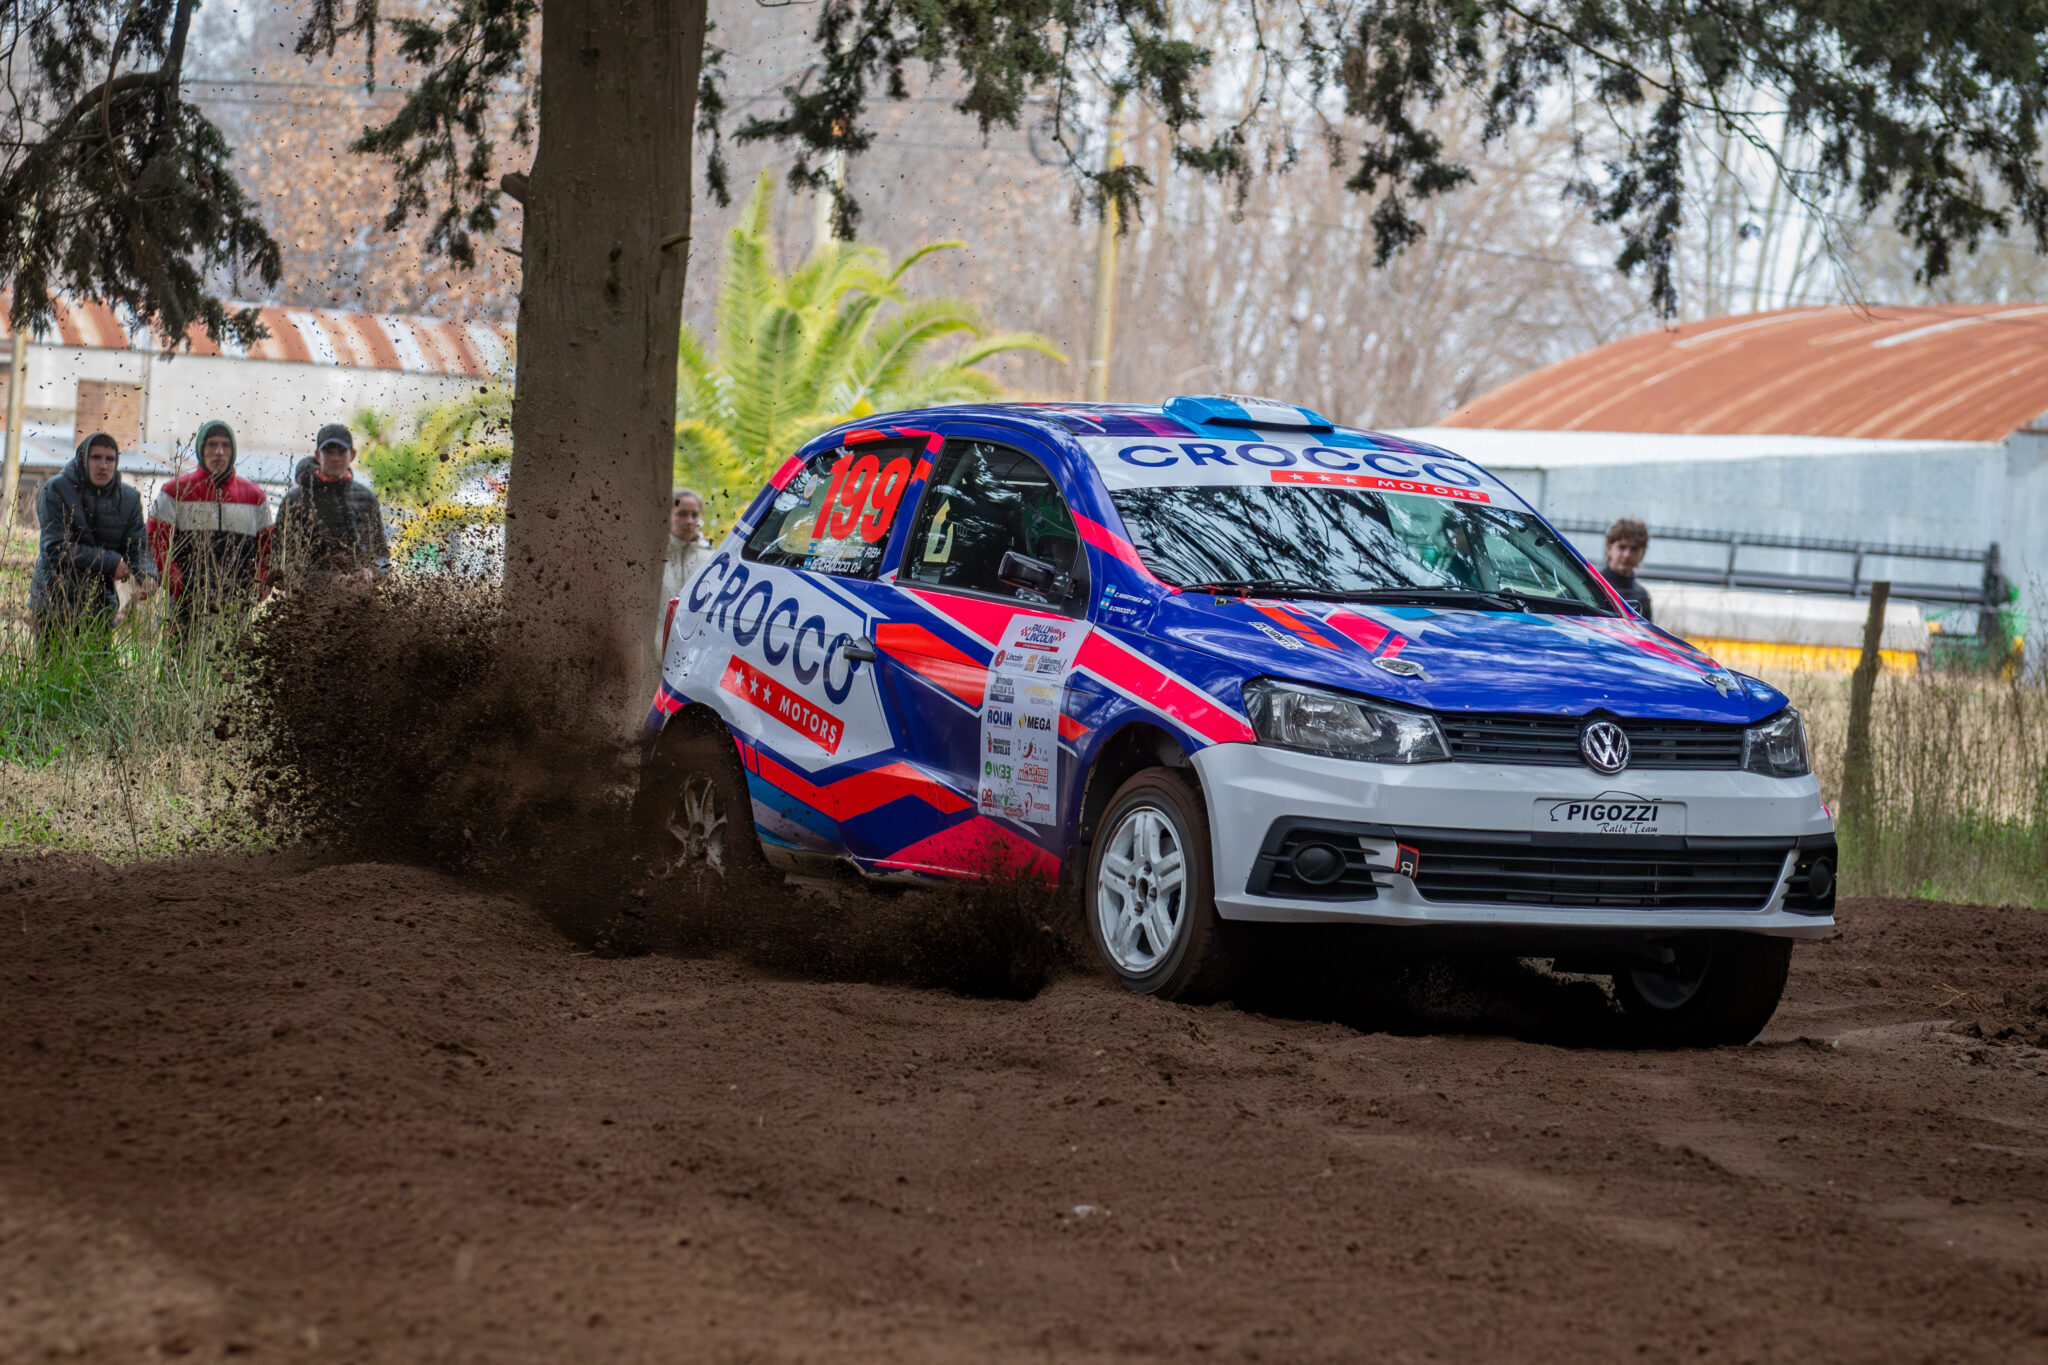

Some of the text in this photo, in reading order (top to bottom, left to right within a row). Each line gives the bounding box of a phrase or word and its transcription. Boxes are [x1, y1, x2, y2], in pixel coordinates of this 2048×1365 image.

[1117, 443, 1481, 487] CROCCO
[811, 454, 912, 543] 199
[1377, 480, 1481, 499] MOTORS
[688, 552, 861, 705] CROCCO
[1025, 631, 1057, 644] LINCOLN
[1030, 624, 1052, 634] RALLY
[779, 695, 838, 744] MOTORS
[987, 709, 1013, 727] ROLIN
[1026, 715, 1051, 731] MEGA
[1567, 804, 1659, 822] PIGOZZI
[1596, 821, 1658, 834] Rally Team
